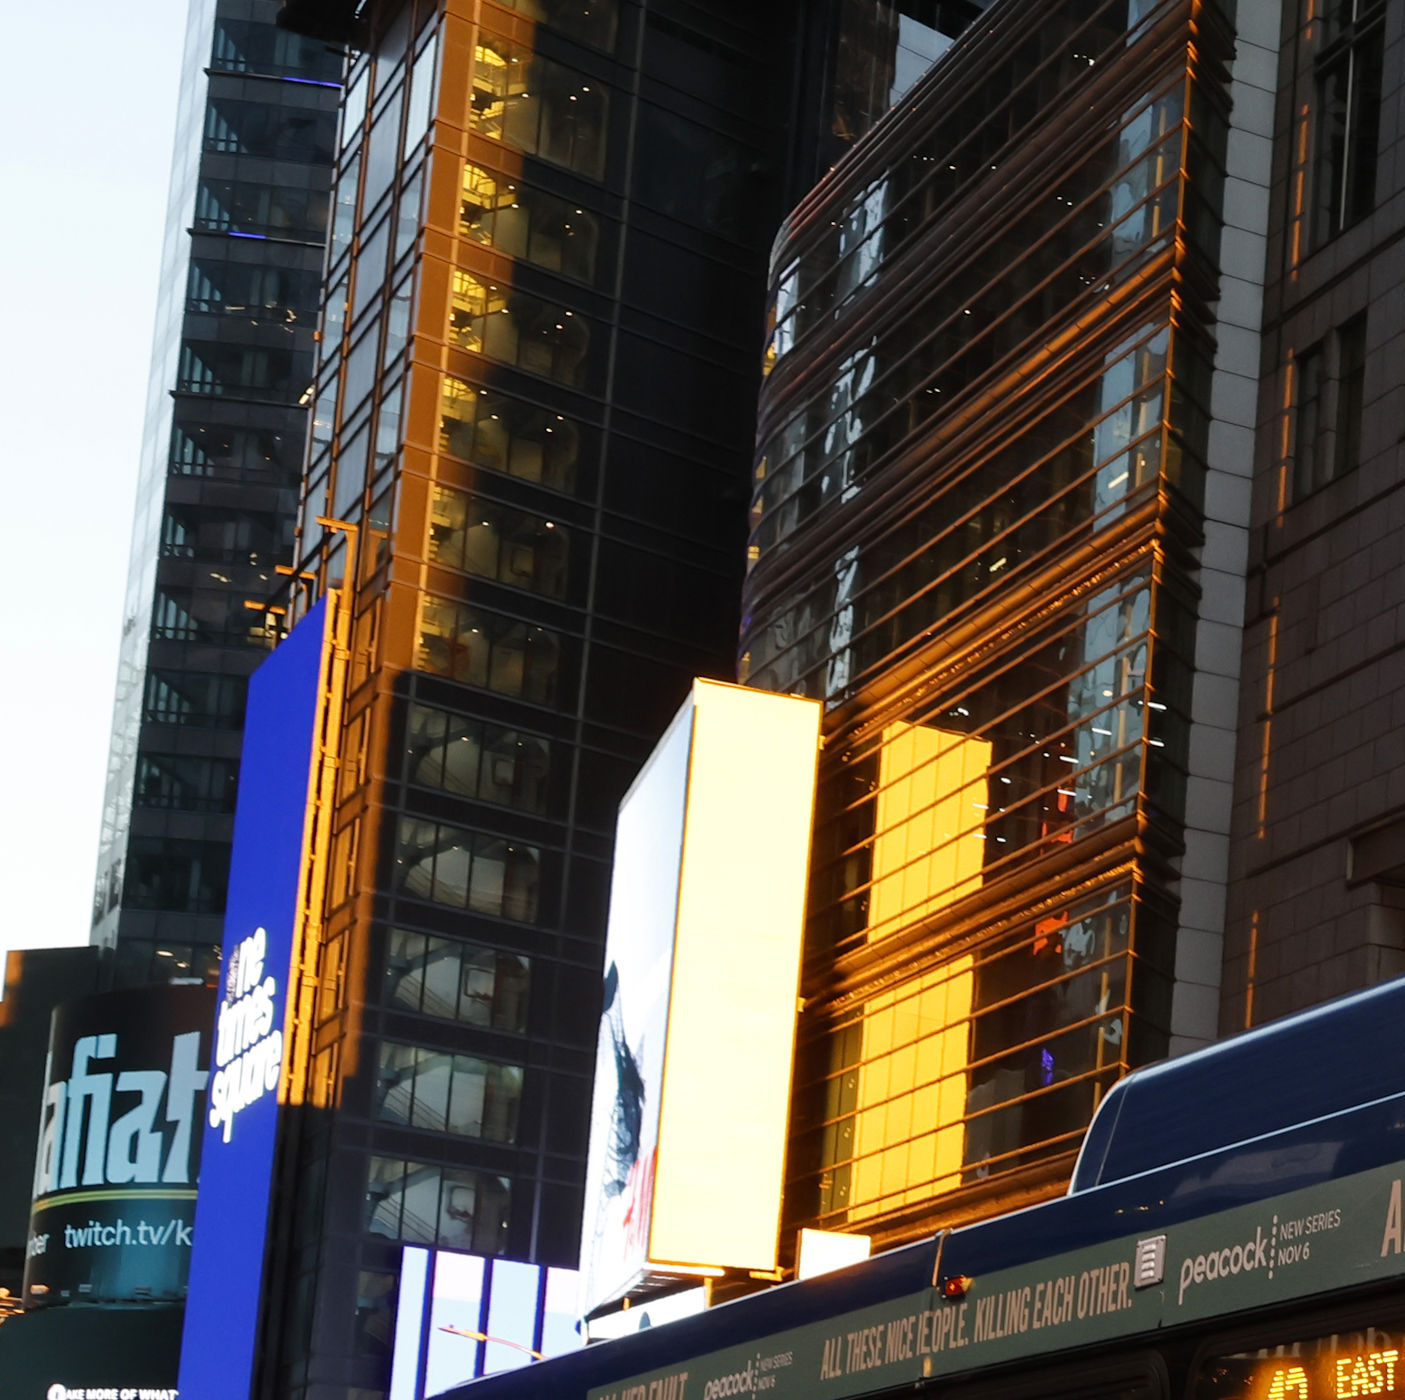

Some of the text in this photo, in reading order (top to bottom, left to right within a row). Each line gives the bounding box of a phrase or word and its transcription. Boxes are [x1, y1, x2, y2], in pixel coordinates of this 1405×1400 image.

[1280, 1208, 1341, 1239] NEW SERIES
[1178, 1226, 1267, 1305] peacock
[1277, 1241, 1310, 1266] NOV 6
[820, 1335, 842, 1381] ALL
[845, 1328, 885, 1375] THESE
[885, 1318, 916, 1362] NICE
[974, 1288, 1030, 1343] KILLING
[1032, 1277, 1073, 1329] EACH
[1077, 1262, 1132, 1318] OTHER.
[86, 1389, 118, 1400] MORE
[120, 1389, 137, 1400] OF
[1336, 1350, 1398, 1399] EAST
